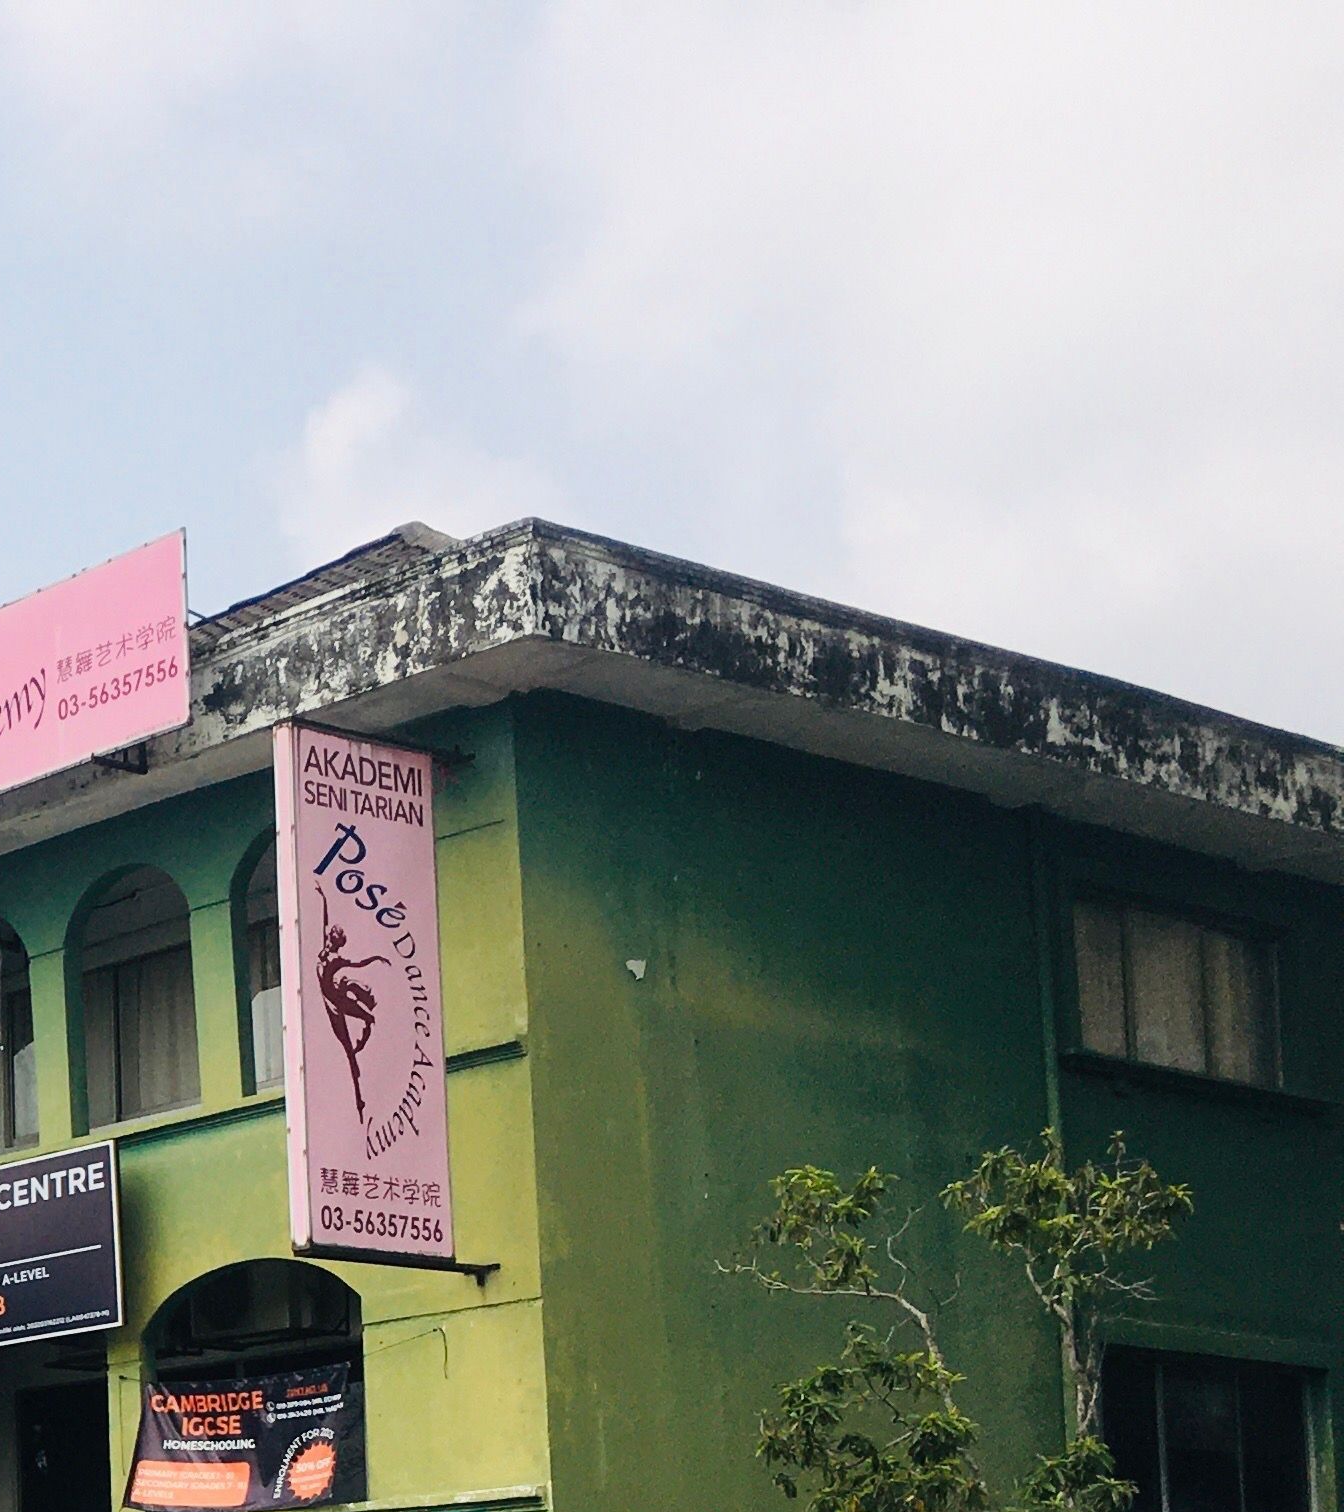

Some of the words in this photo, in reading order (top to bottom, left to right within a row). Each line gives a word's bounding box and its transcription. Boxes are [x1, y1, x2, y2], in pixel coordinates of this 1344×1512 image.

[56, 615, 176, 683] 慧舞艺术学院
[57, 656, 179, 721] 03-56357556
[304, 745, 423, 797] AKADEMI
[304, 780, 348, 814] SENI
[350, 787, 425, 827] TARIAN
[314, 822, 405, 929] Posé
[393, 931, 430, 1043] Dance
[366, 1046, 434, 1160] Academy
[320, 1167, 442, 1208] 慧舞艺术学院
[321, 1204, 443, 1243] 03-56357556
[2, 1267, 50, 1290] A-LEVEL
[151, 1391, 264, 1413] CAMBRIDGE
[182, 1415, 242, 1436] IGCSE
[163, 1439, 256, 1451] HOMESCHOOLING
